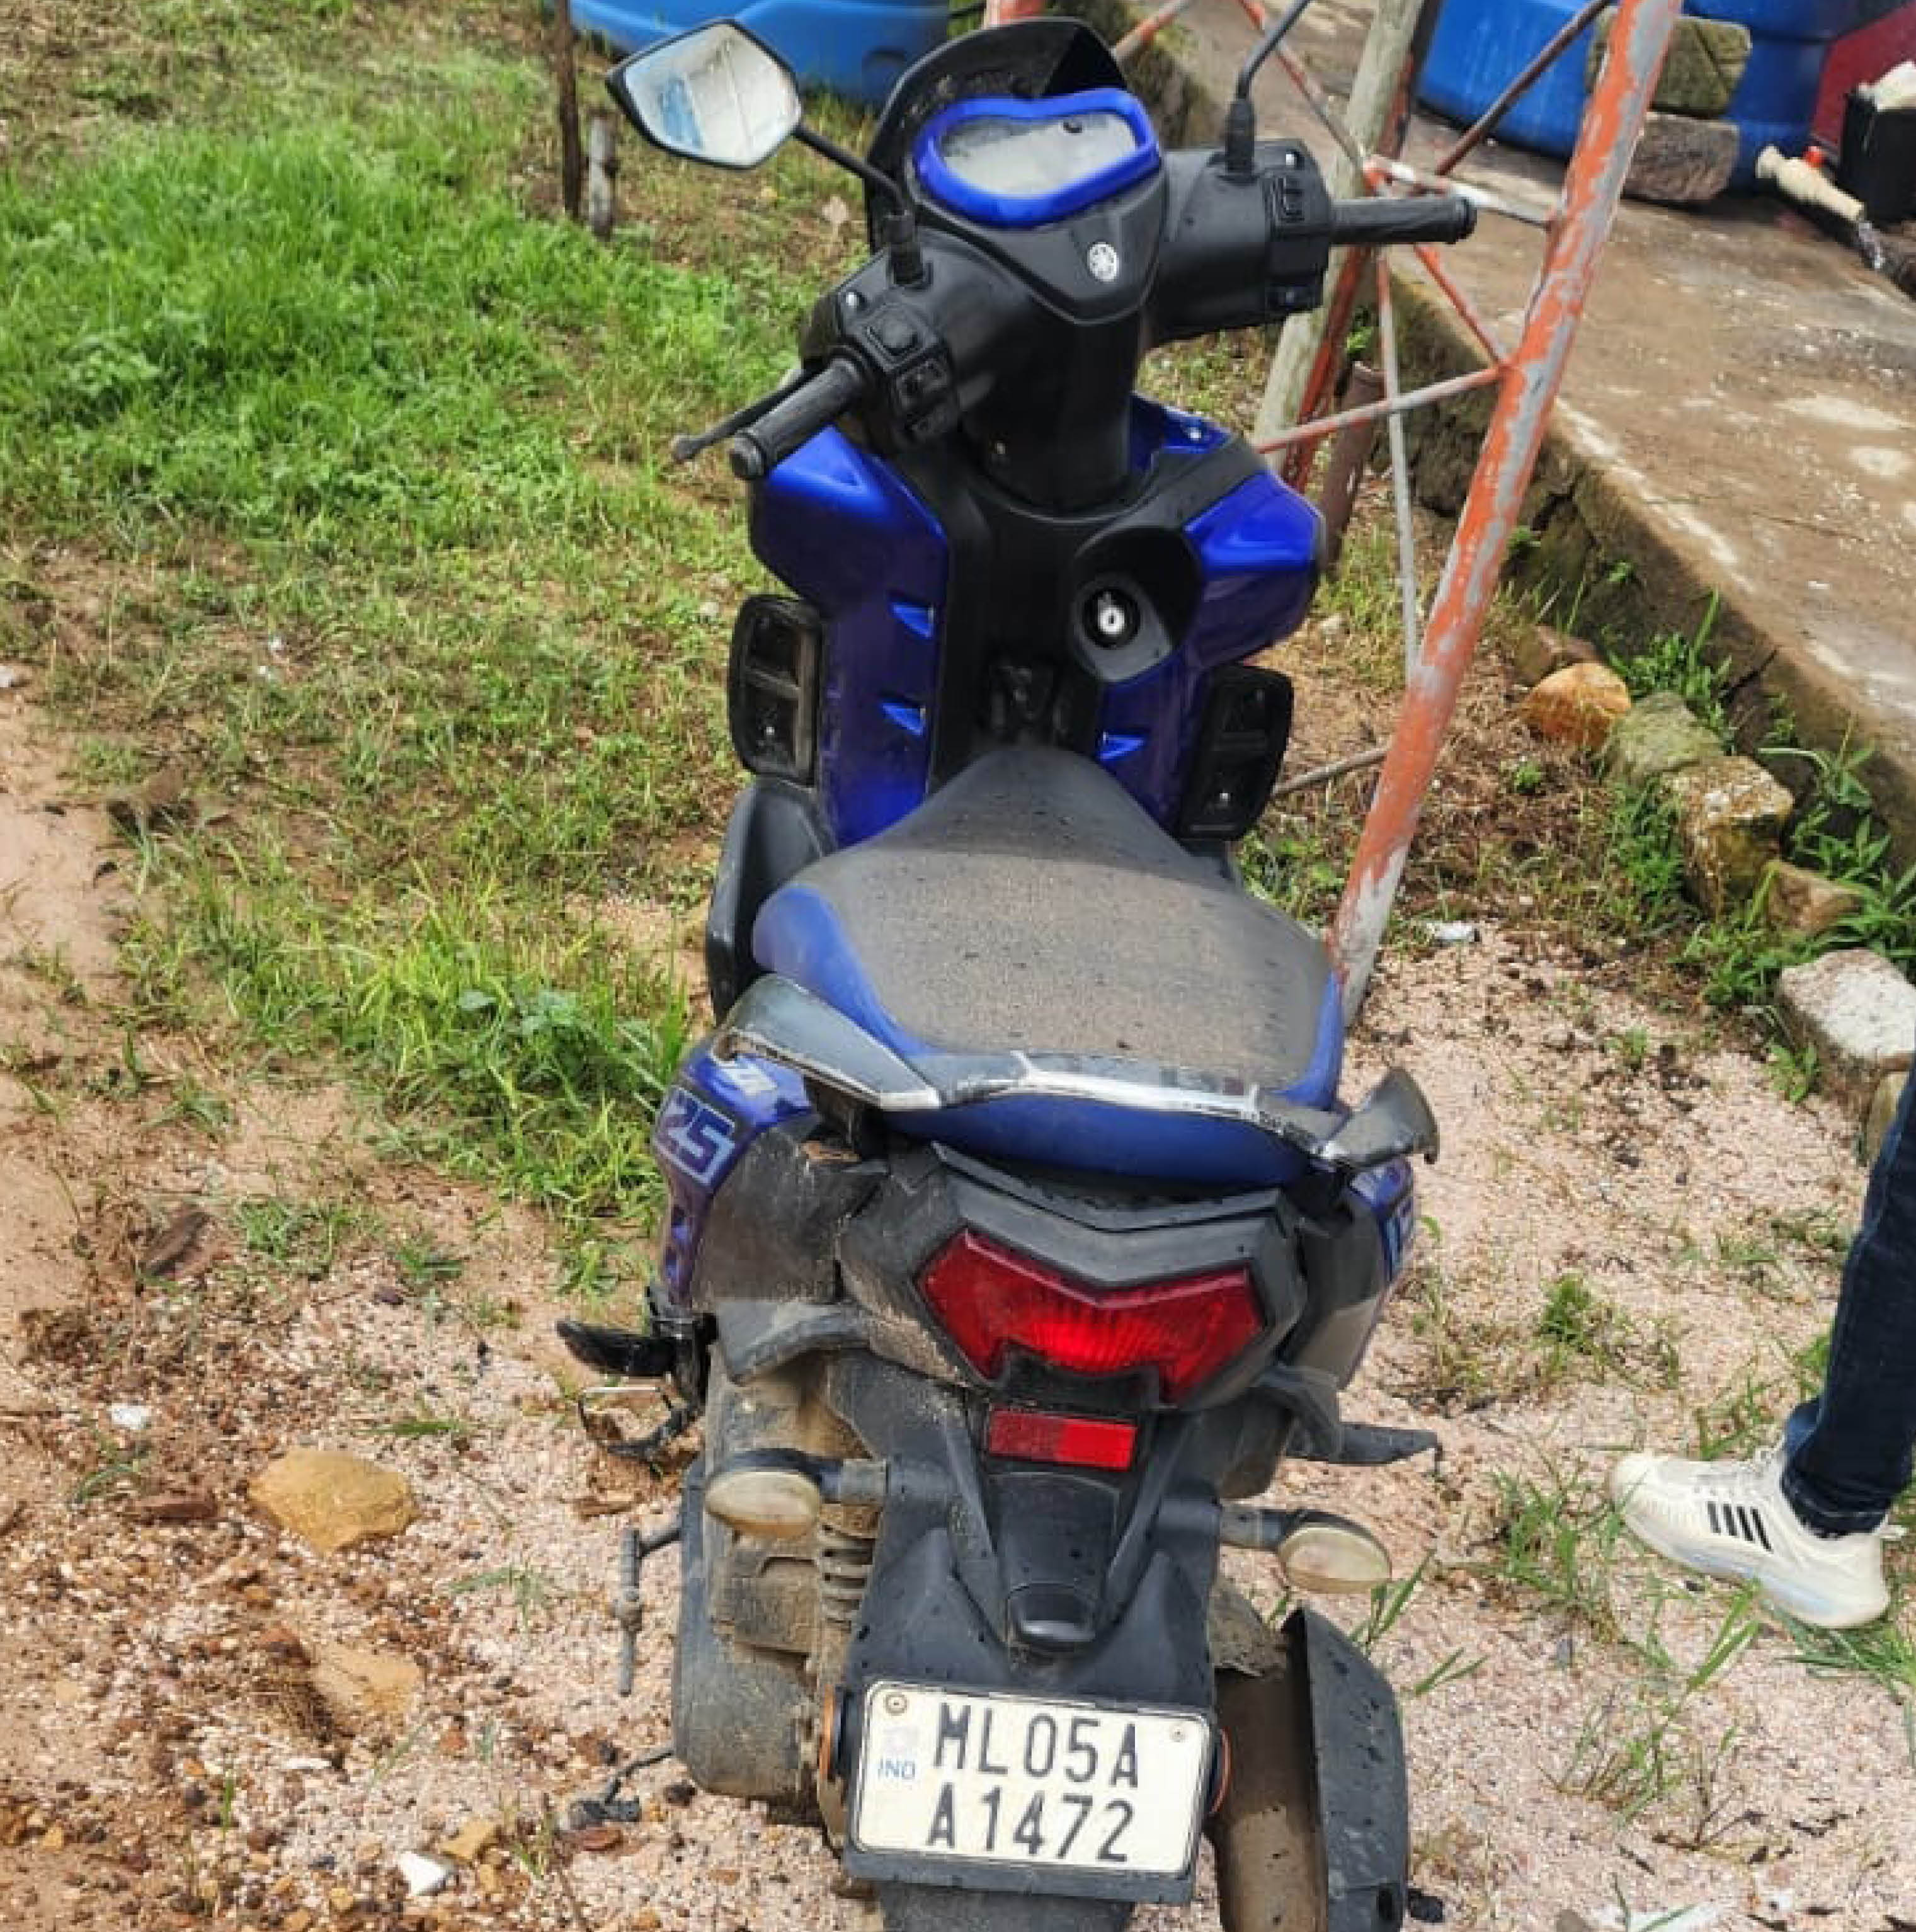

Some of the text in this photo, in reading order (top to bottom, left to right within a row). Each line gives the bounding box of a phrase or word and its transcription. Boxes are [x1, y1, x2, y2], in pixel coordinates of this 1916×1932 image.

[877, 1758, 916, 1780] IND
[933, 1702, 1138, 1788] ML05A
[927, 1782, 1134, 1862] A1472
